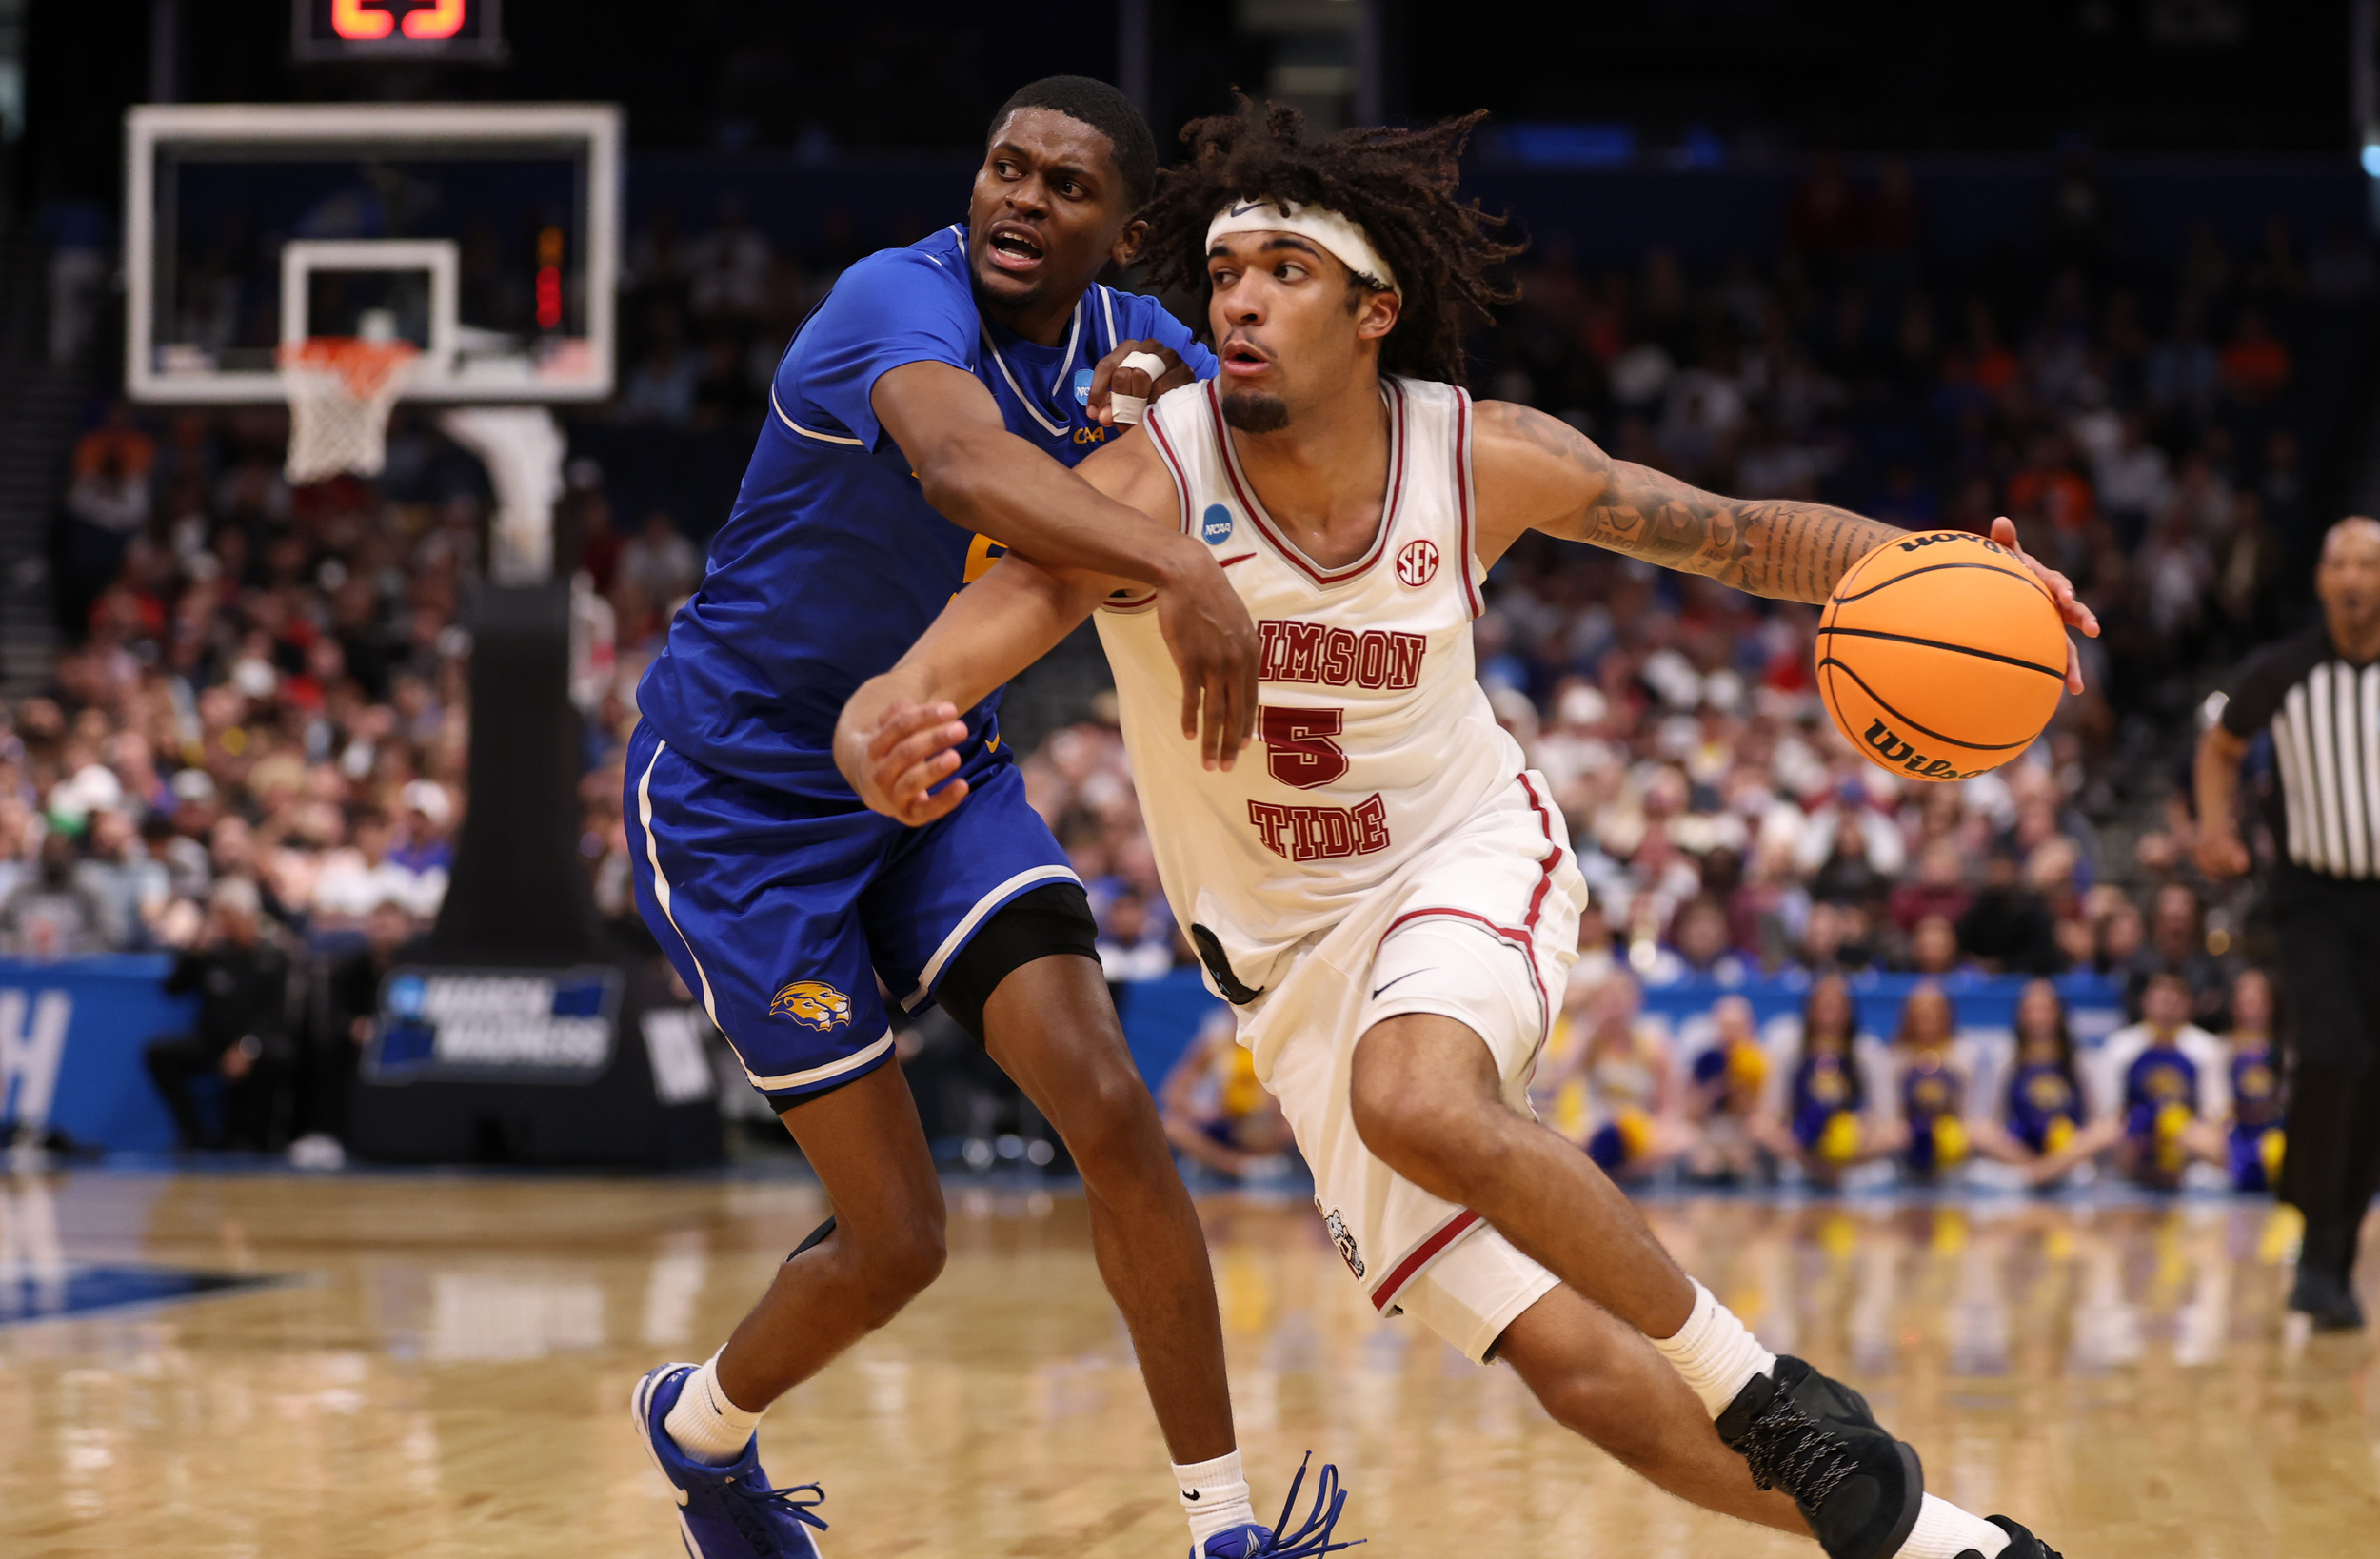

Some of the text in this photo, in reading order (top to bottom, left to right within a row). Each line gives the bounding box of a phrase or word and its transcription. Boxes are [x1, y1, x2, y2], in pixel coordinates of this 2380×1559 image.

[1073, 426, 1106, 444] CAA
[1205, 523, 1232, 535] NCAA
[1398, 542, 1438, 585] SEC
[1258, 620, 1427, 691] IMSON
[1258, 704, 1350, 791] 5
[1864, 716, 1999, 780] Wilso
[1247, 792, 1391, 862] TIDE
